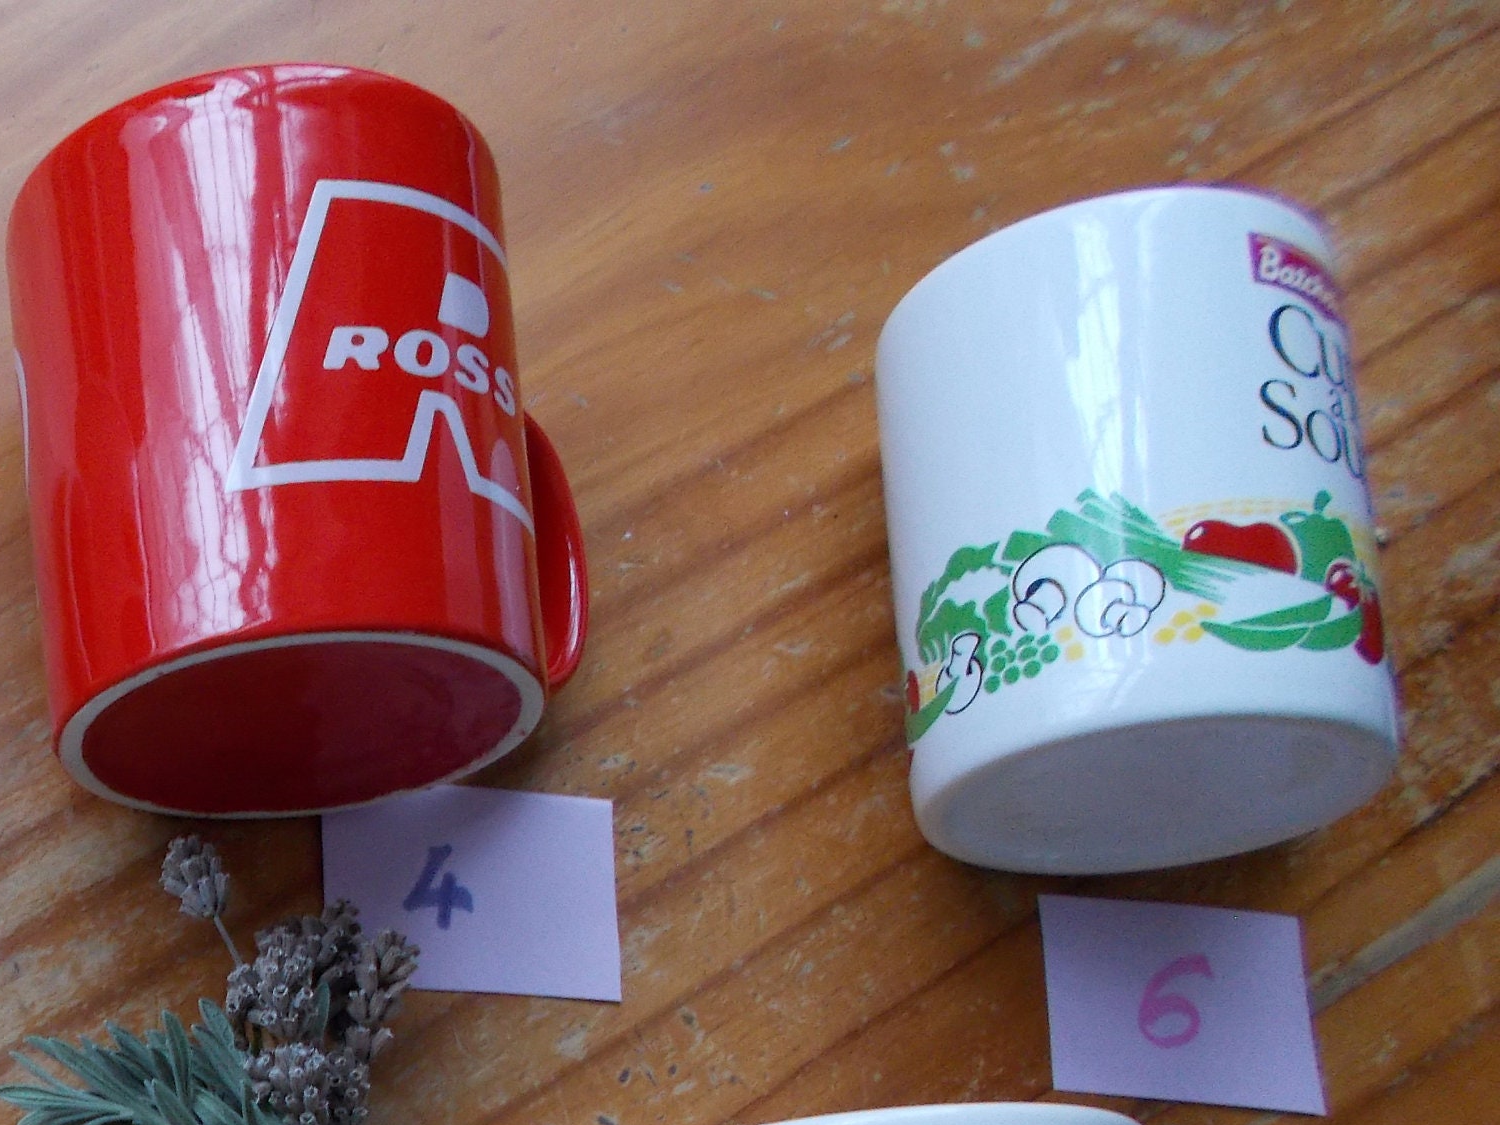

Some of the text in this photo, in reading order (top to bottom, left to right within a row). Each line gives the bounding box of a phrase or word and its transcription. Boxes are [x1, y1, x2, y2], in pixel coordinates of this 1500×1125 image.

[323, 326, 516, 416] ROSS
[402, 844, 474, 929] 4
[1137, 954, 1216, 1048] 6
